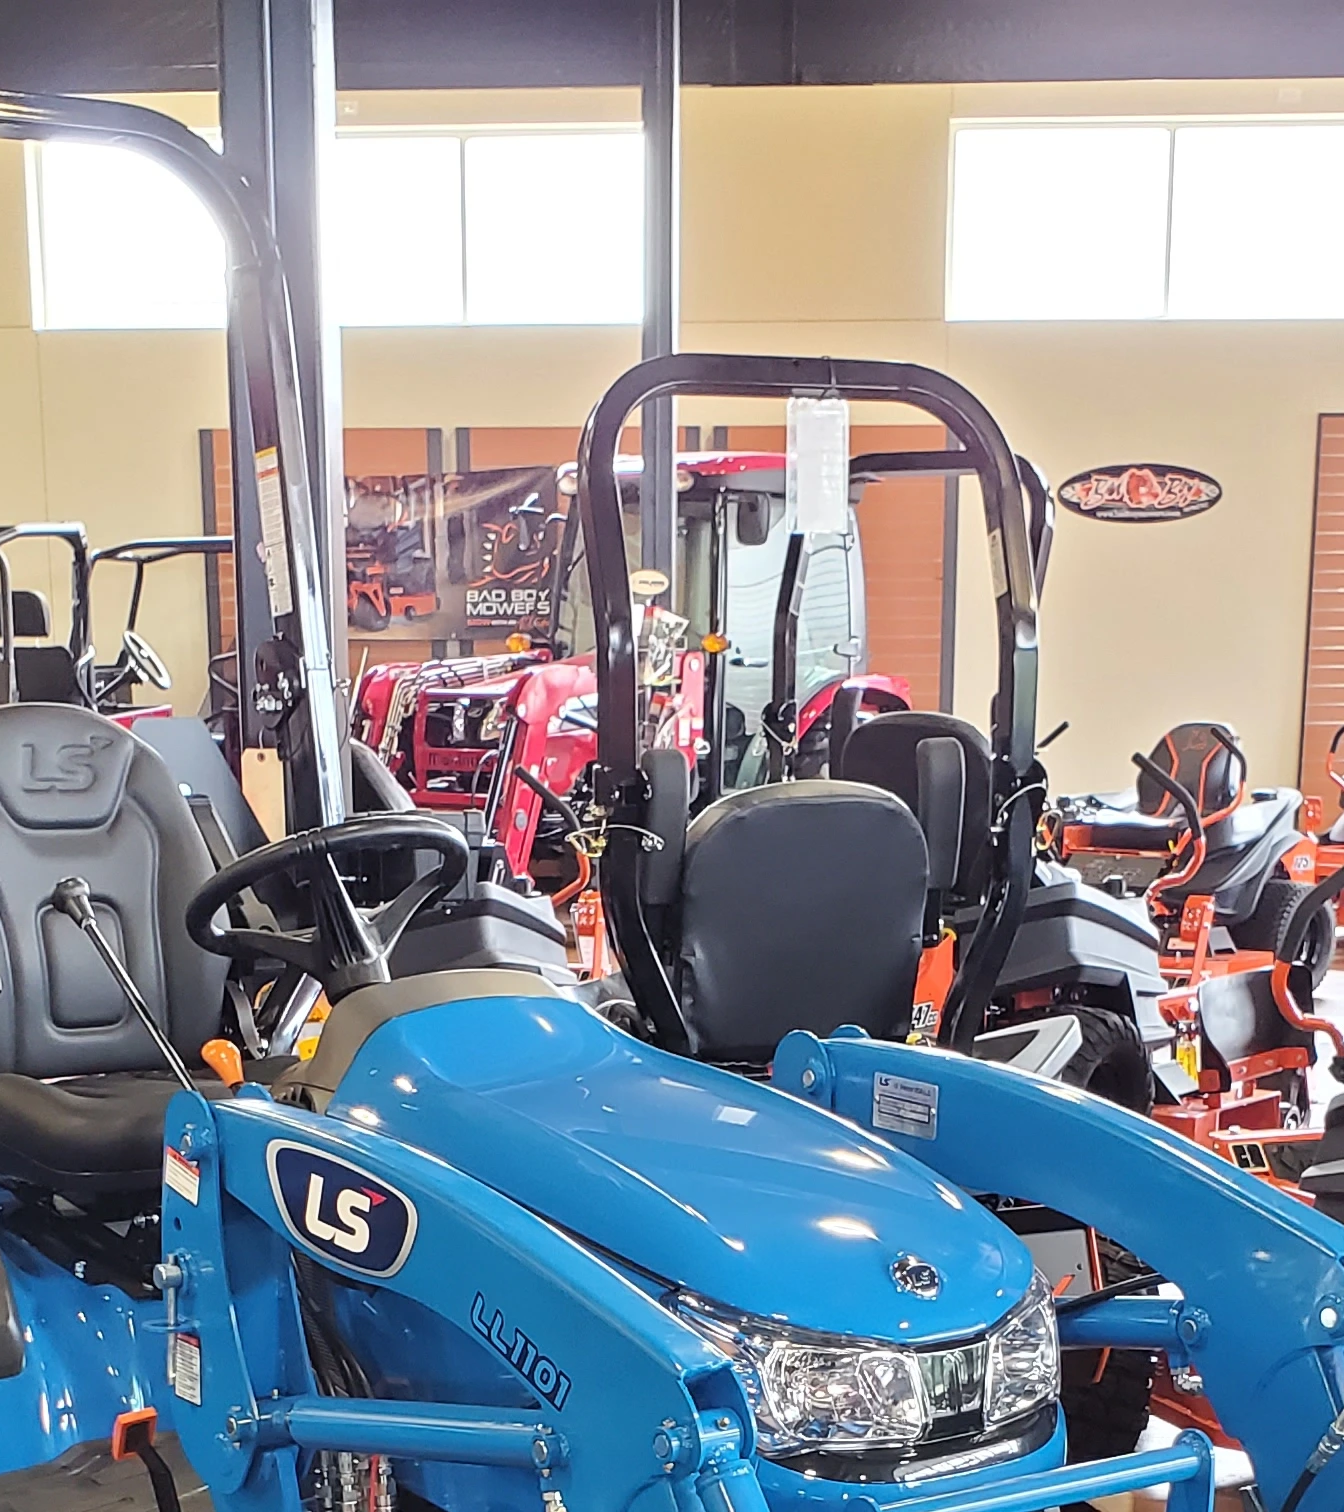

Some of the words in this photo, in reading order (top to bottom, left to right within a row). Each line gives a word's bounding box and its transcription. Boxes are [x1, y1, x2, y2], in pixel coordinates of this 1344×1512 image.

[466, 589, 506, 603] BAD
[511, 588, 550, 602] BOY
[466, 601, 551, 616] MOWERS
[21, 743, 96, 792] LS
[305, 1172, 371, 1254] LS
[470, 1291, 572, 1412] LL1101
